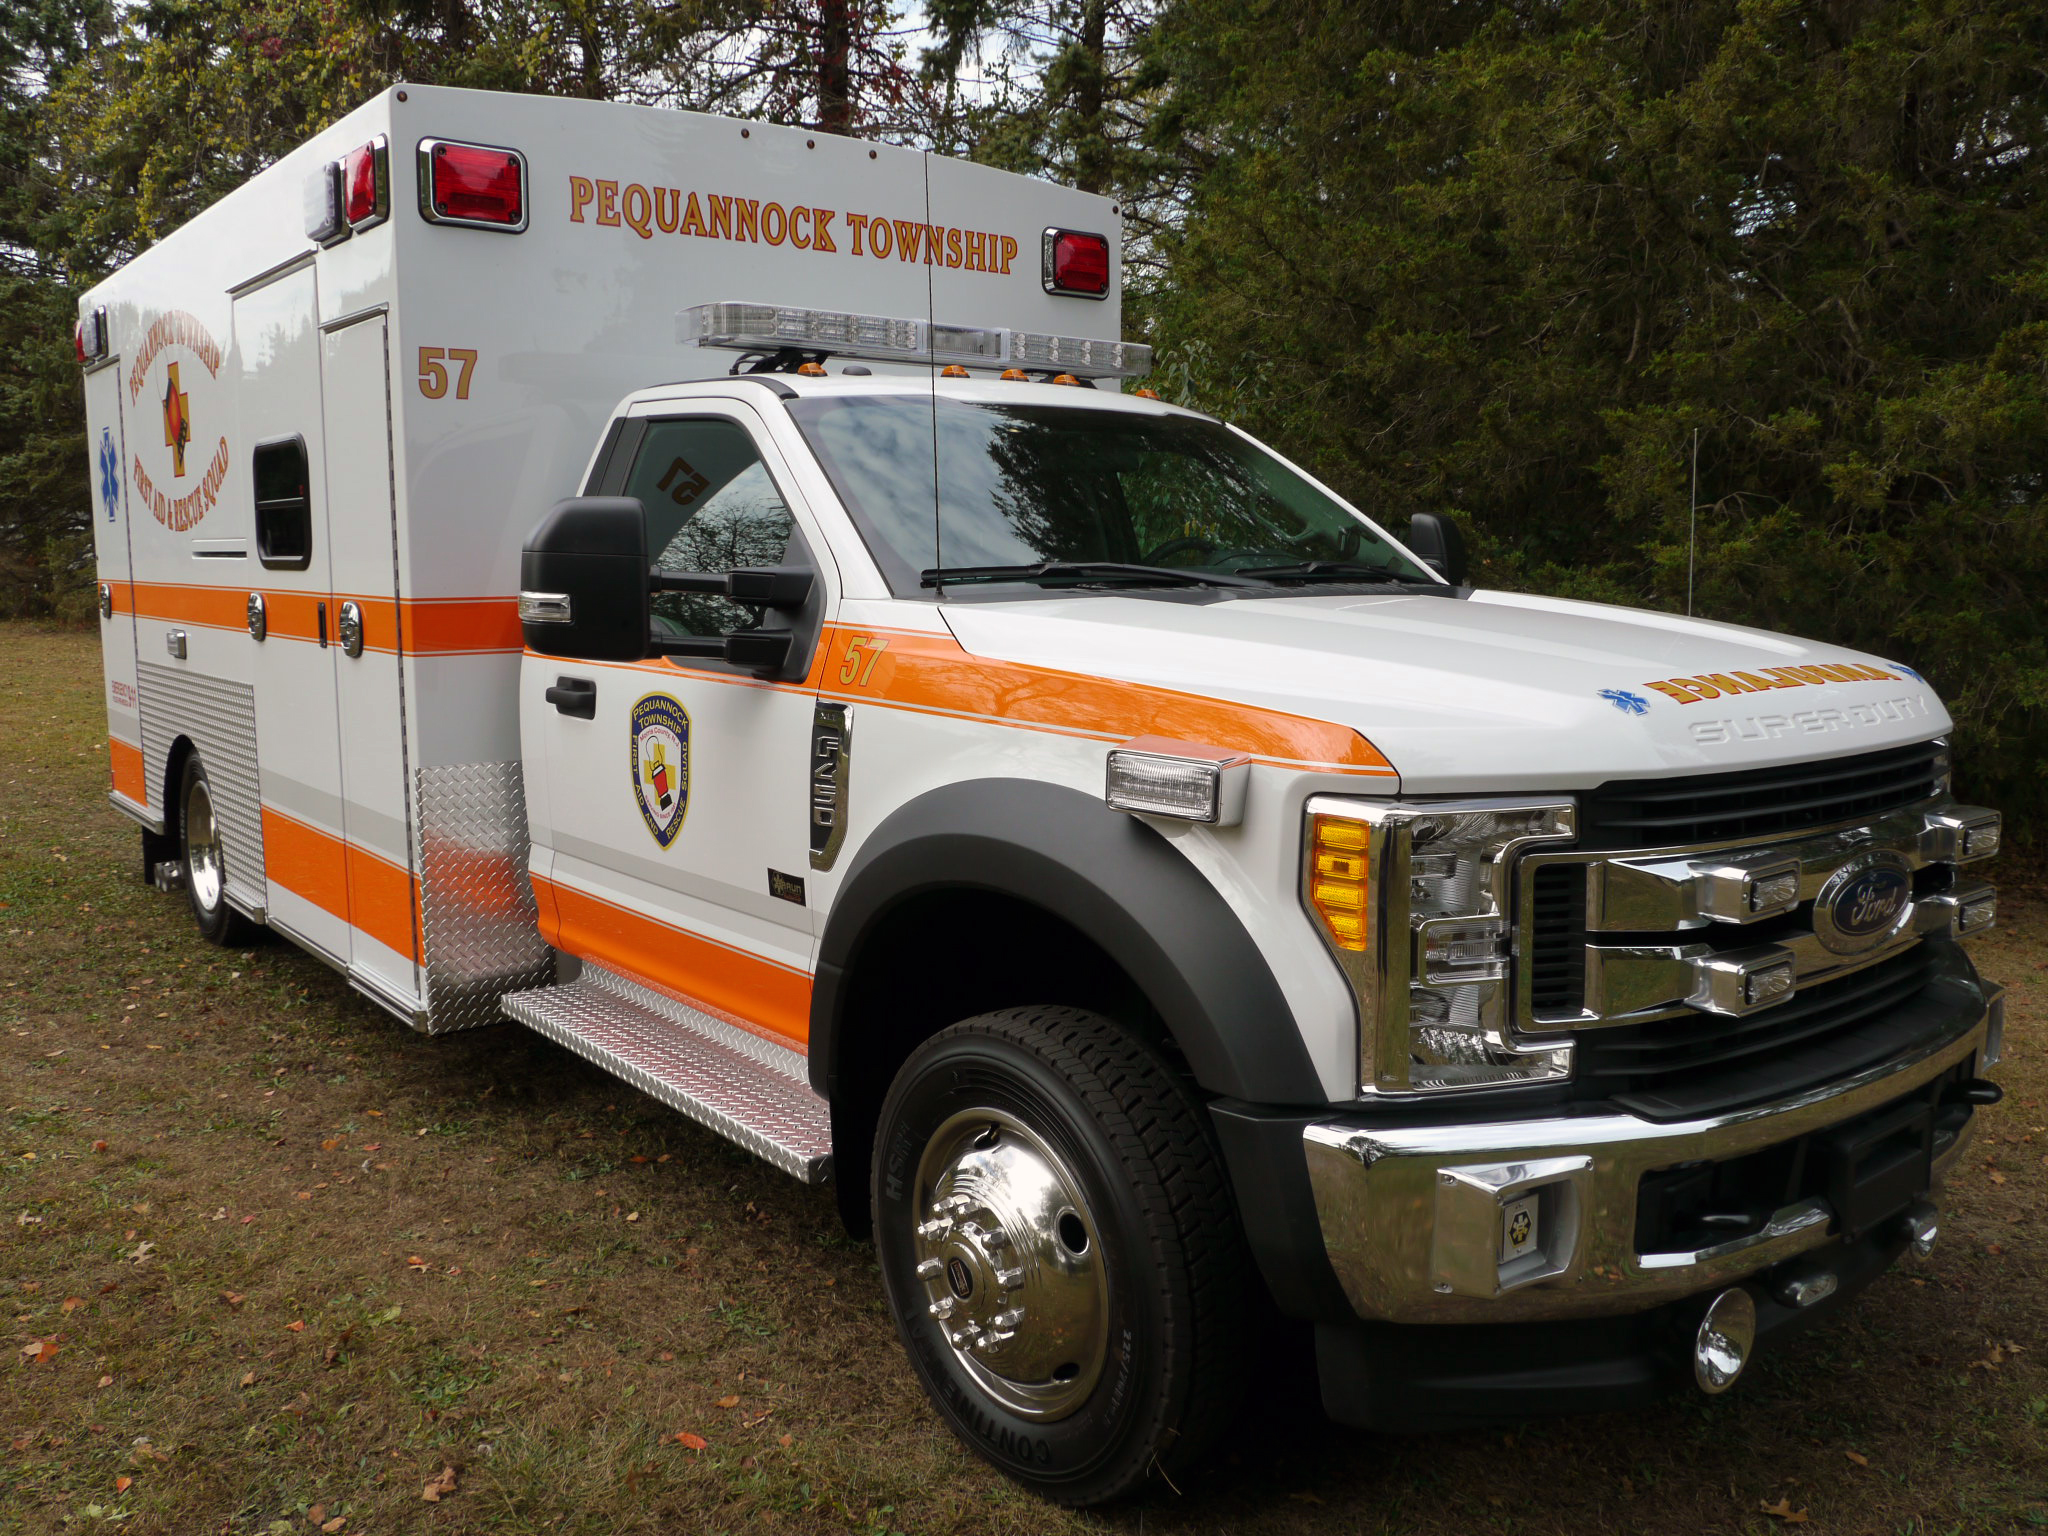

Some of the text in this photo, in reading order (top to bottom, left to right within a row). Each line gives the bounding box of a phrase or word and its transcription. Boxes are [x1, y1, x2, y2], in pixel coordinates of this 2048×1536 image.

[569, 176, 1018, 274] PEQUANNOCK TOWNSHIP
[418, 346, 478, 400] 57
[133, 453, 152, 511] FIRST
[153, 488, 166, 526] AID
[174, 485, 204, 532] RESCUE
[203, 435, 229, 513] SQUAD
[839, 635, 891, 687] 57
[633, 699, 688, 730] PEQUANNOCK
[638, 714, 682, 734] TOWNSHIP
[1688, 695, 1930, 746] SUPER DUTY
[635, 784, 645, 806] AID
[645, 813, 659, 836] AND
[665, 797, 686, 839] RESCUE
[681, 741, 689, 791] SQUAD
[1851, 884, 1898, 926] Ford
